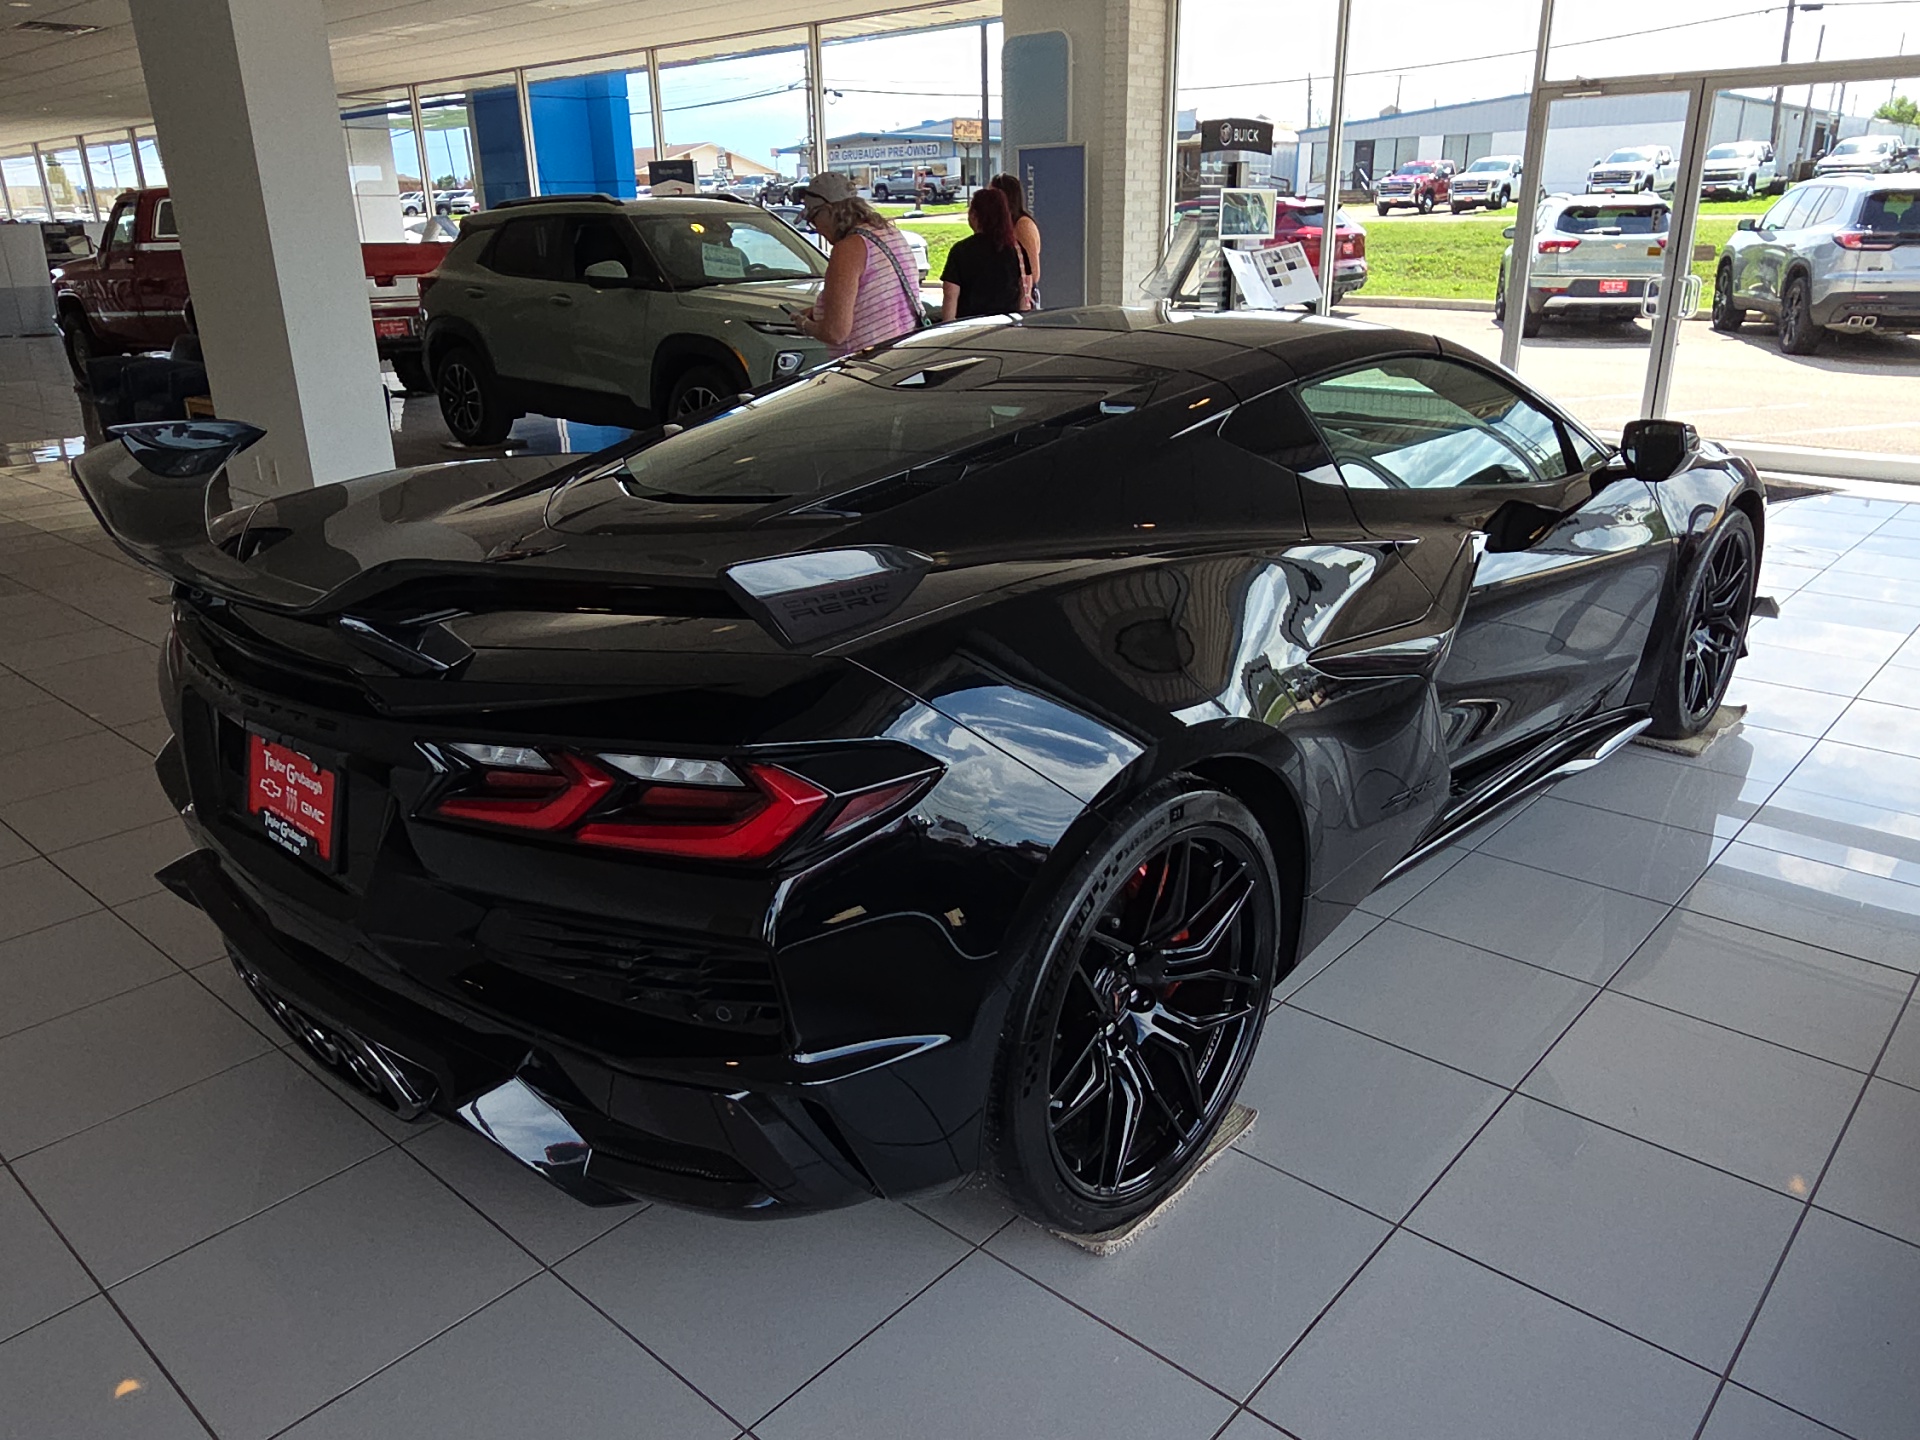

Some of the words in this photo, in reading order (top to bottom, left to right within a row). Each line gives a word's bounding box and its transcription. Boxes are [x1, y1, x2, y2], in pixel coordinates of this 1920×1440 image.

[1233, 127, 1259, 142] BUICK
[842, 147, 886, 160] GRUBAUGH
[888, 143, 938, 159] PRE-OWNED
[783, 581, 889, 609] CARBON
[263, 750, 287, 773] Taylor
[286, 763, 323, 796] Grubaugh
[300, 800, 325, 825] GMC
[1172, 808, 1182, 820] 21
